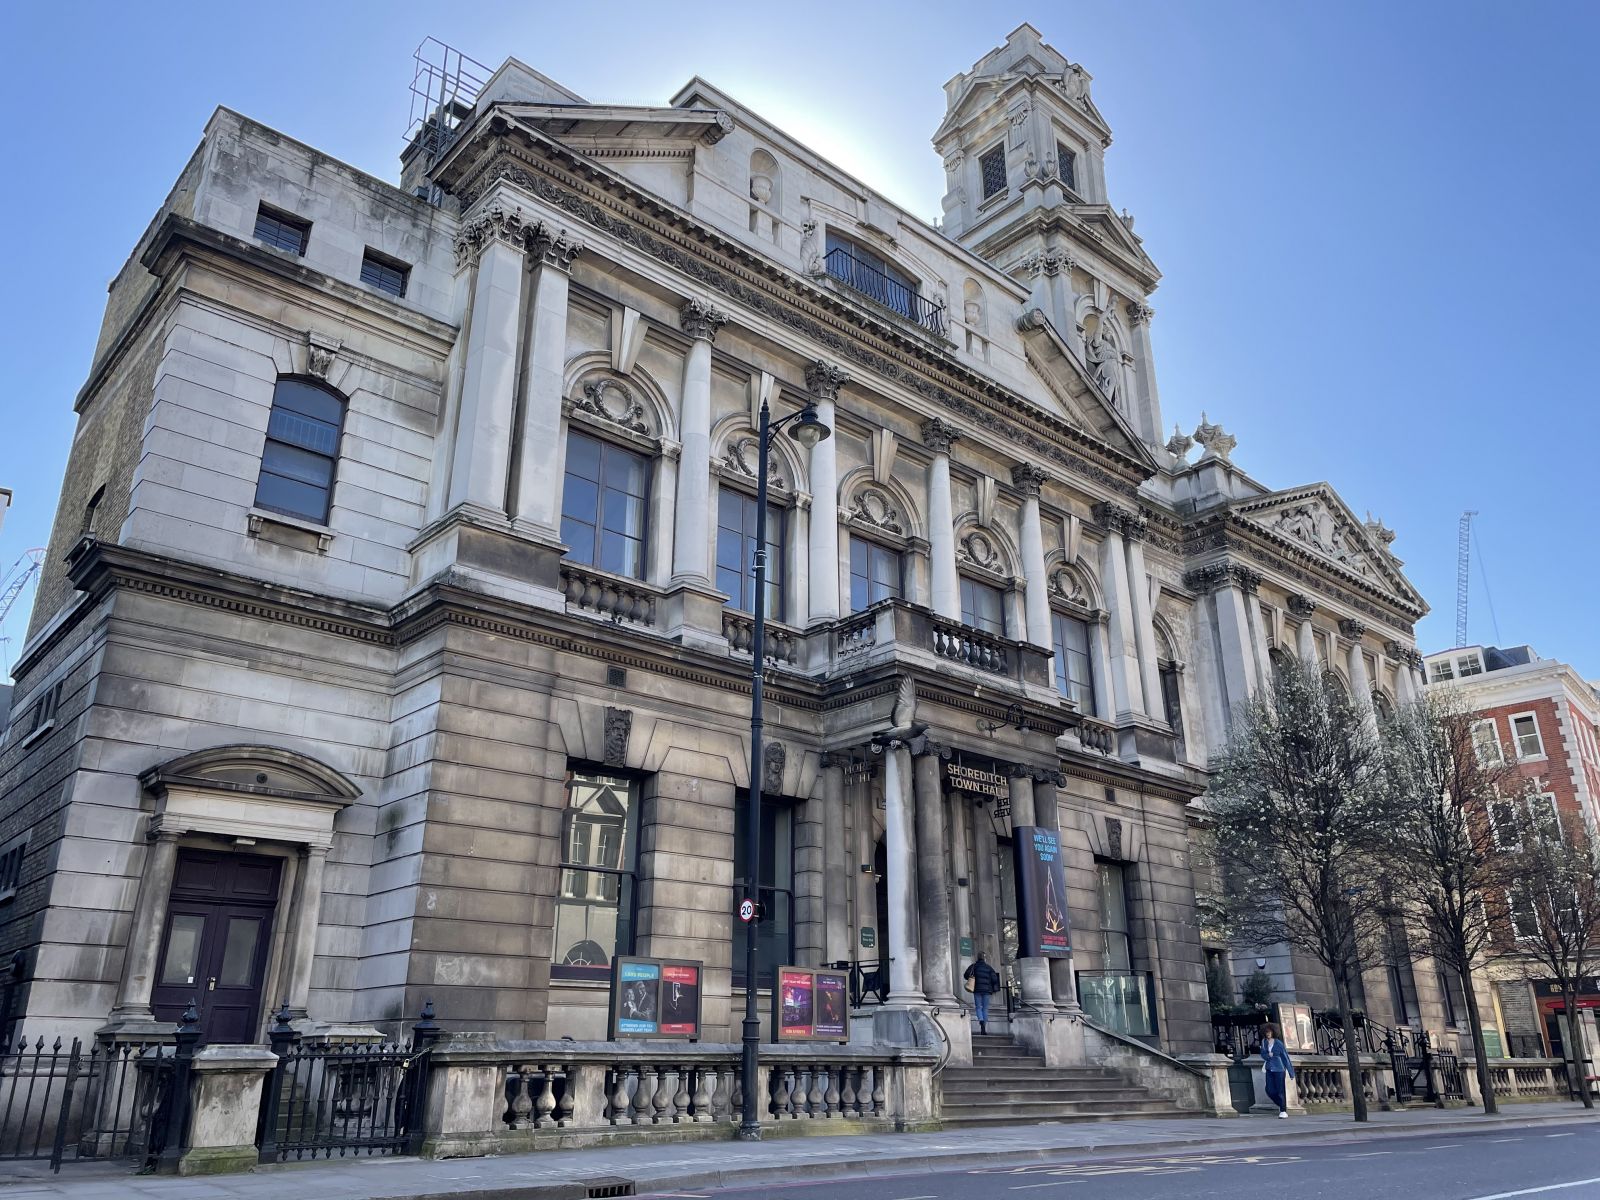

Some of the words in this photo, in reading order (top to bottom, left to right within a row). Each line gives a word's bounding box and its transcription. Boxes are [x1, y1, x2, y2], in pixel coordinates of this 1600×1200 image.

[947, 763, 1007, 786] SHOREDITCH
[950, 776, 980, 792] TOWN
[982, 783, 1005, 799] HALL
[741, 905, 752, 915] 20
